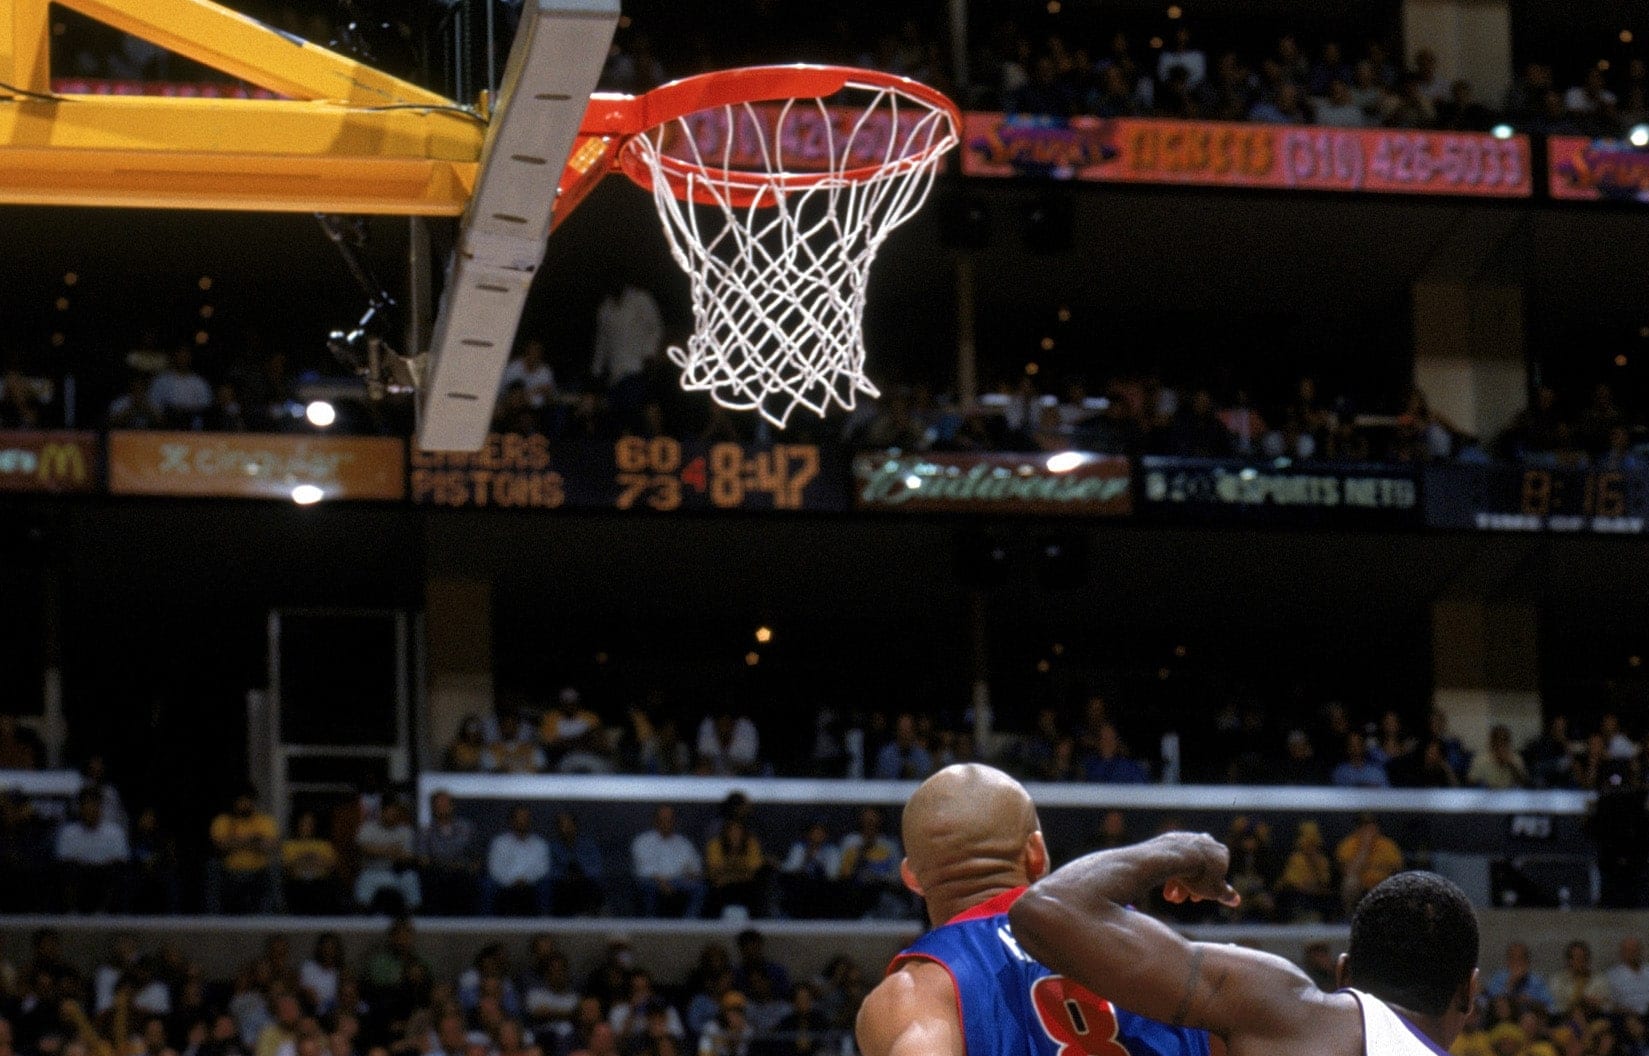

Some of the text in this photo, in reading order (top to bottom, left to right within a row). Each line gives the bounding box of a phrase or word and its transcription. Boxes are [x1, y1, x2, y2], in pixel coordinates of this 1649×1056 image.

[614, 435, 682, 474] 60
[709, 441, 821, 511] 8:47
[410, 470, 682, 512] PISTONS 73
[1522, 470, 1626, 517] 8:16
